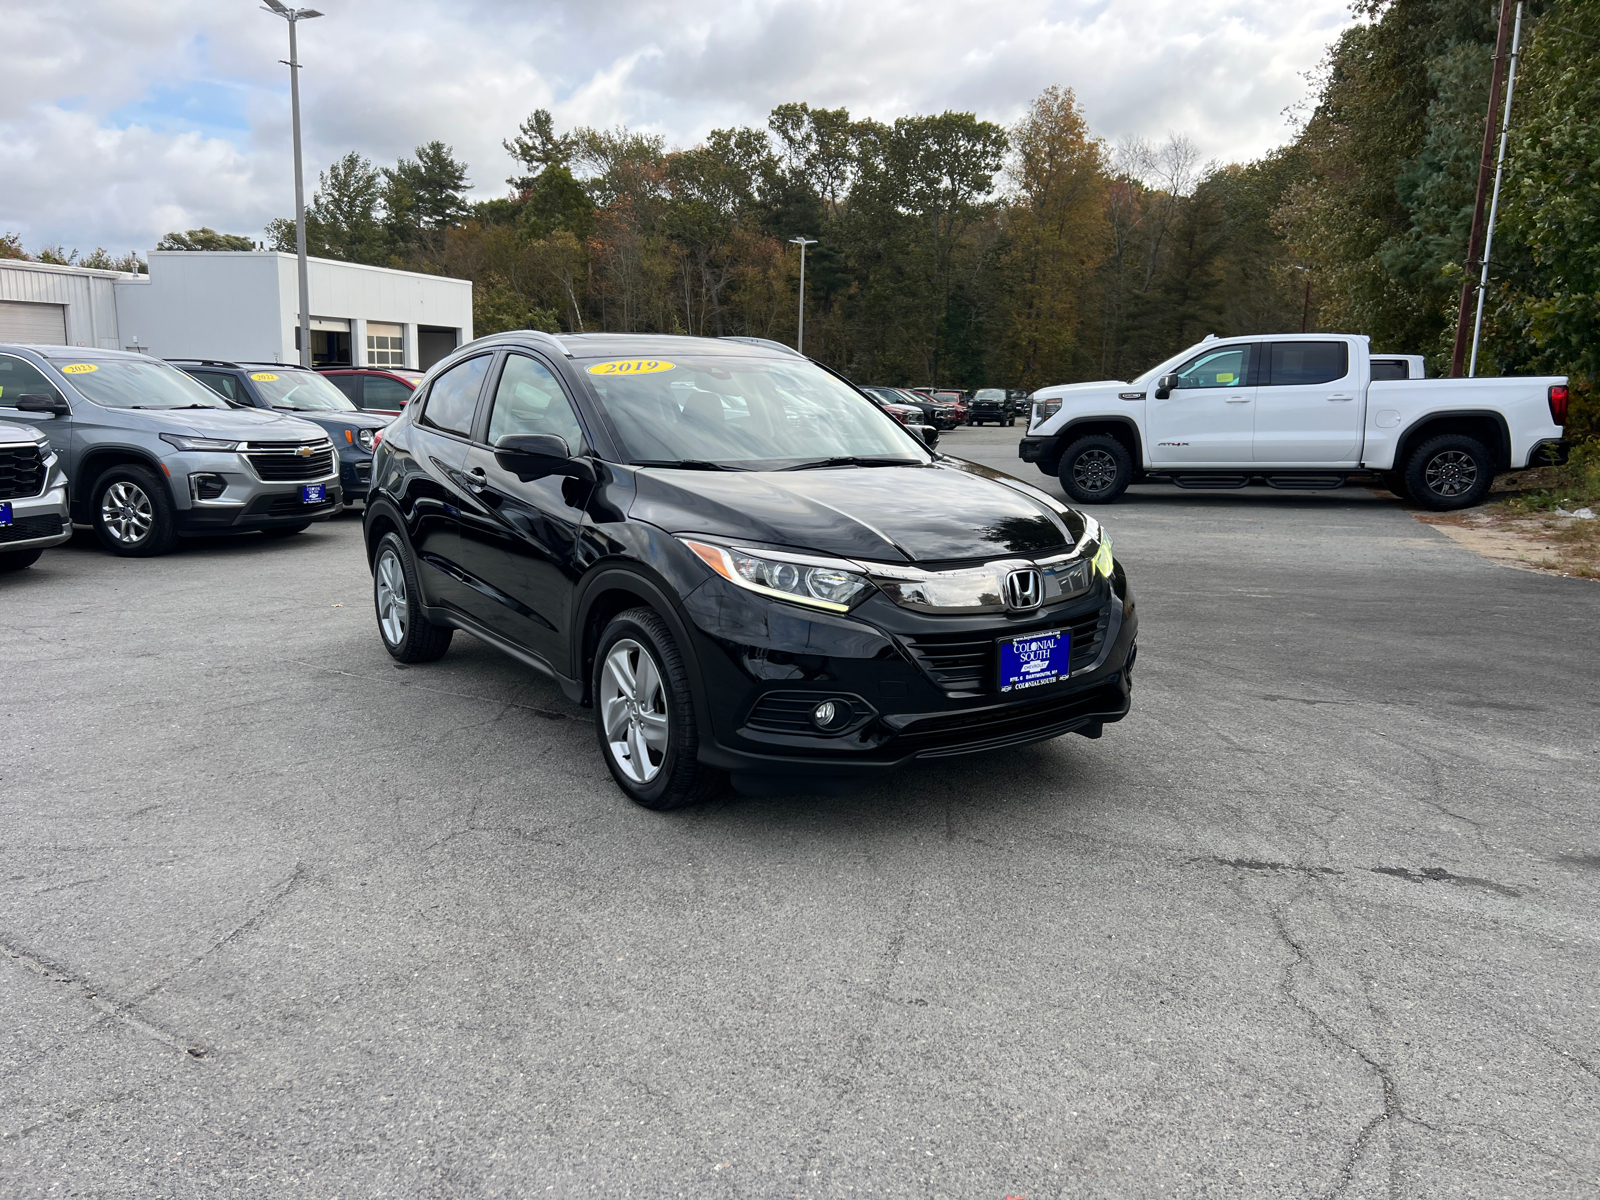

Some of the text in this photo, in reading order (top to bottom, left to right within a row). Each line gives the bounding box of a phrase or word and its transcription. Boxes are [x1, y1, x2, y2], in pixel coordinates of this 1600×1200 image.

[69, 364, 93, 373] 2023
[604, 361, 659, 373] 2019
[1014, 639, 1057, 653] COLONIAL
[1020, 649, 1050, 662] SOUTH
[1024, 662, 1046, 670] CHEVROLET
[1015, 677, 1056, 690] COLONIAL SOUTH
